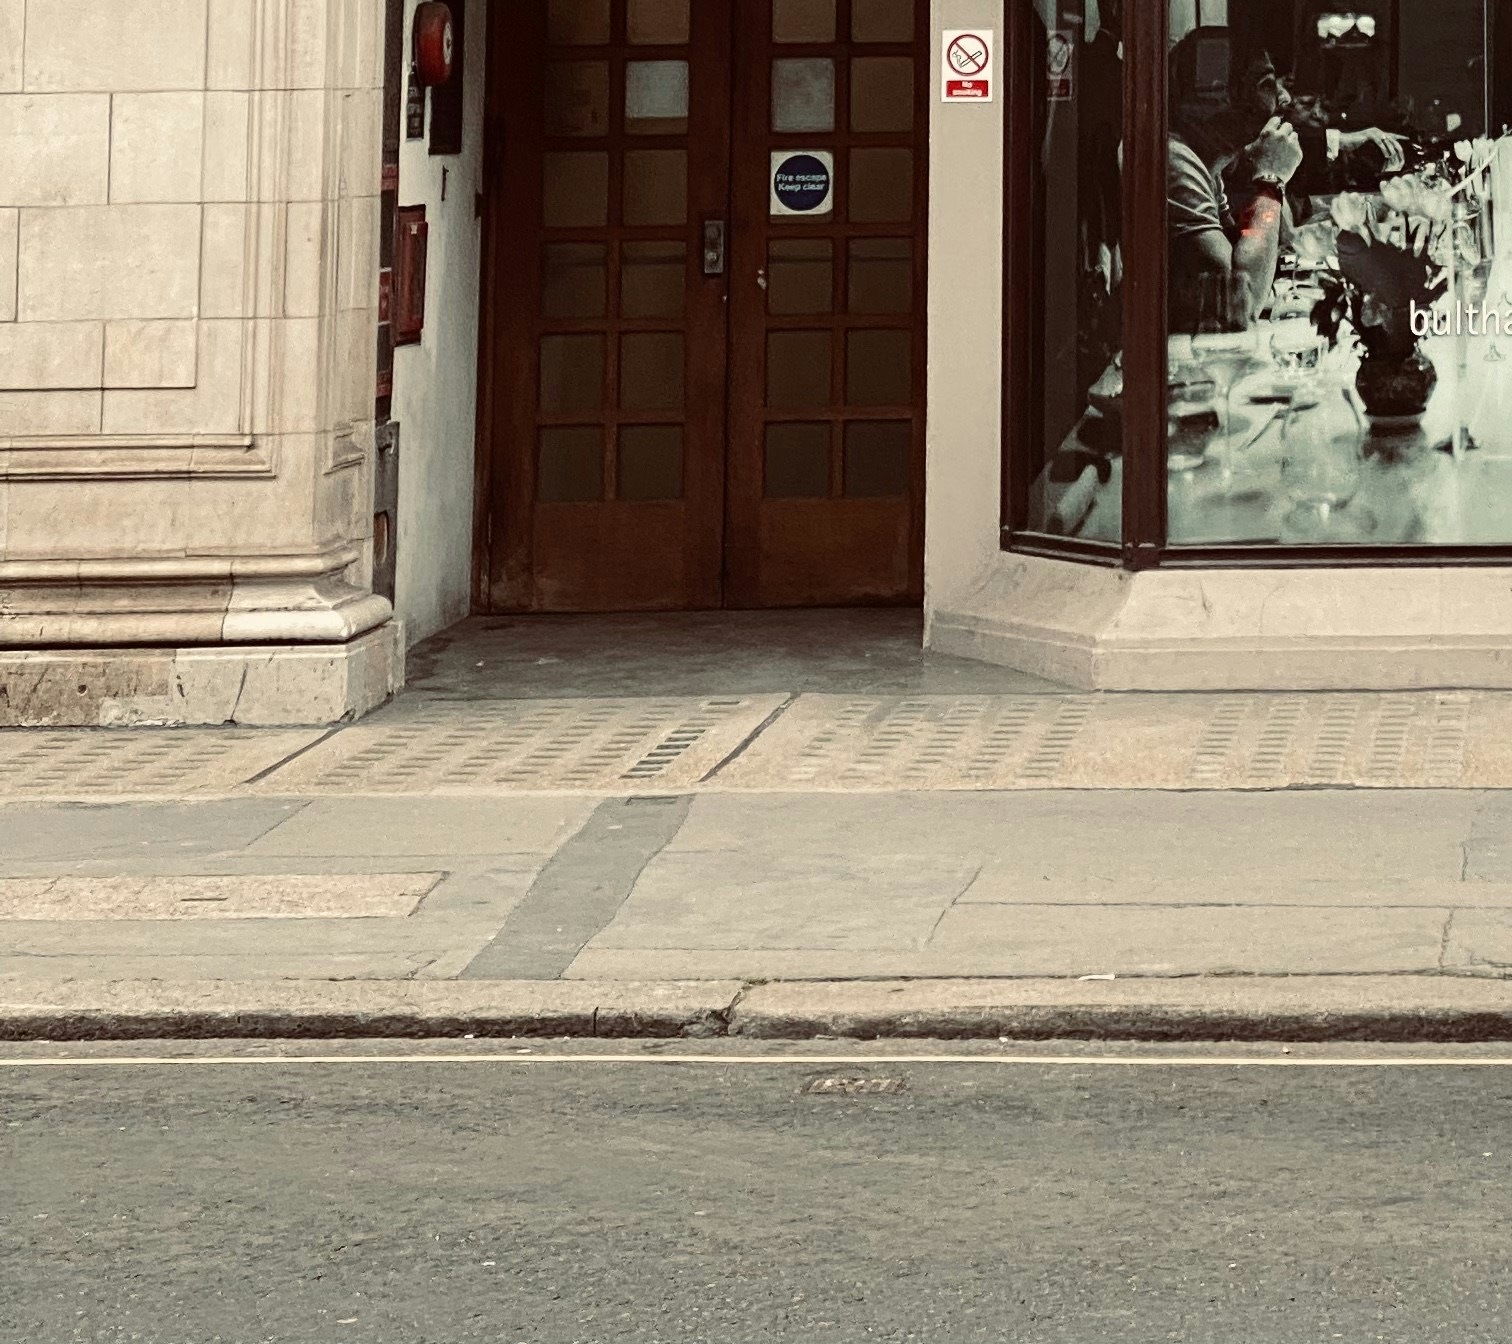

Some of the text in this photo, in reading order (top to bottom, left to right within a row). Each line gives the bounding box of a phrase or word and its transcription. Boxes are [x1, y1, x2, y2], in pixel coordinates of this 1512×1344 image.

[776, 174, 827, 183] Fire escape
[778, 183, 825, 192] Keep clear
